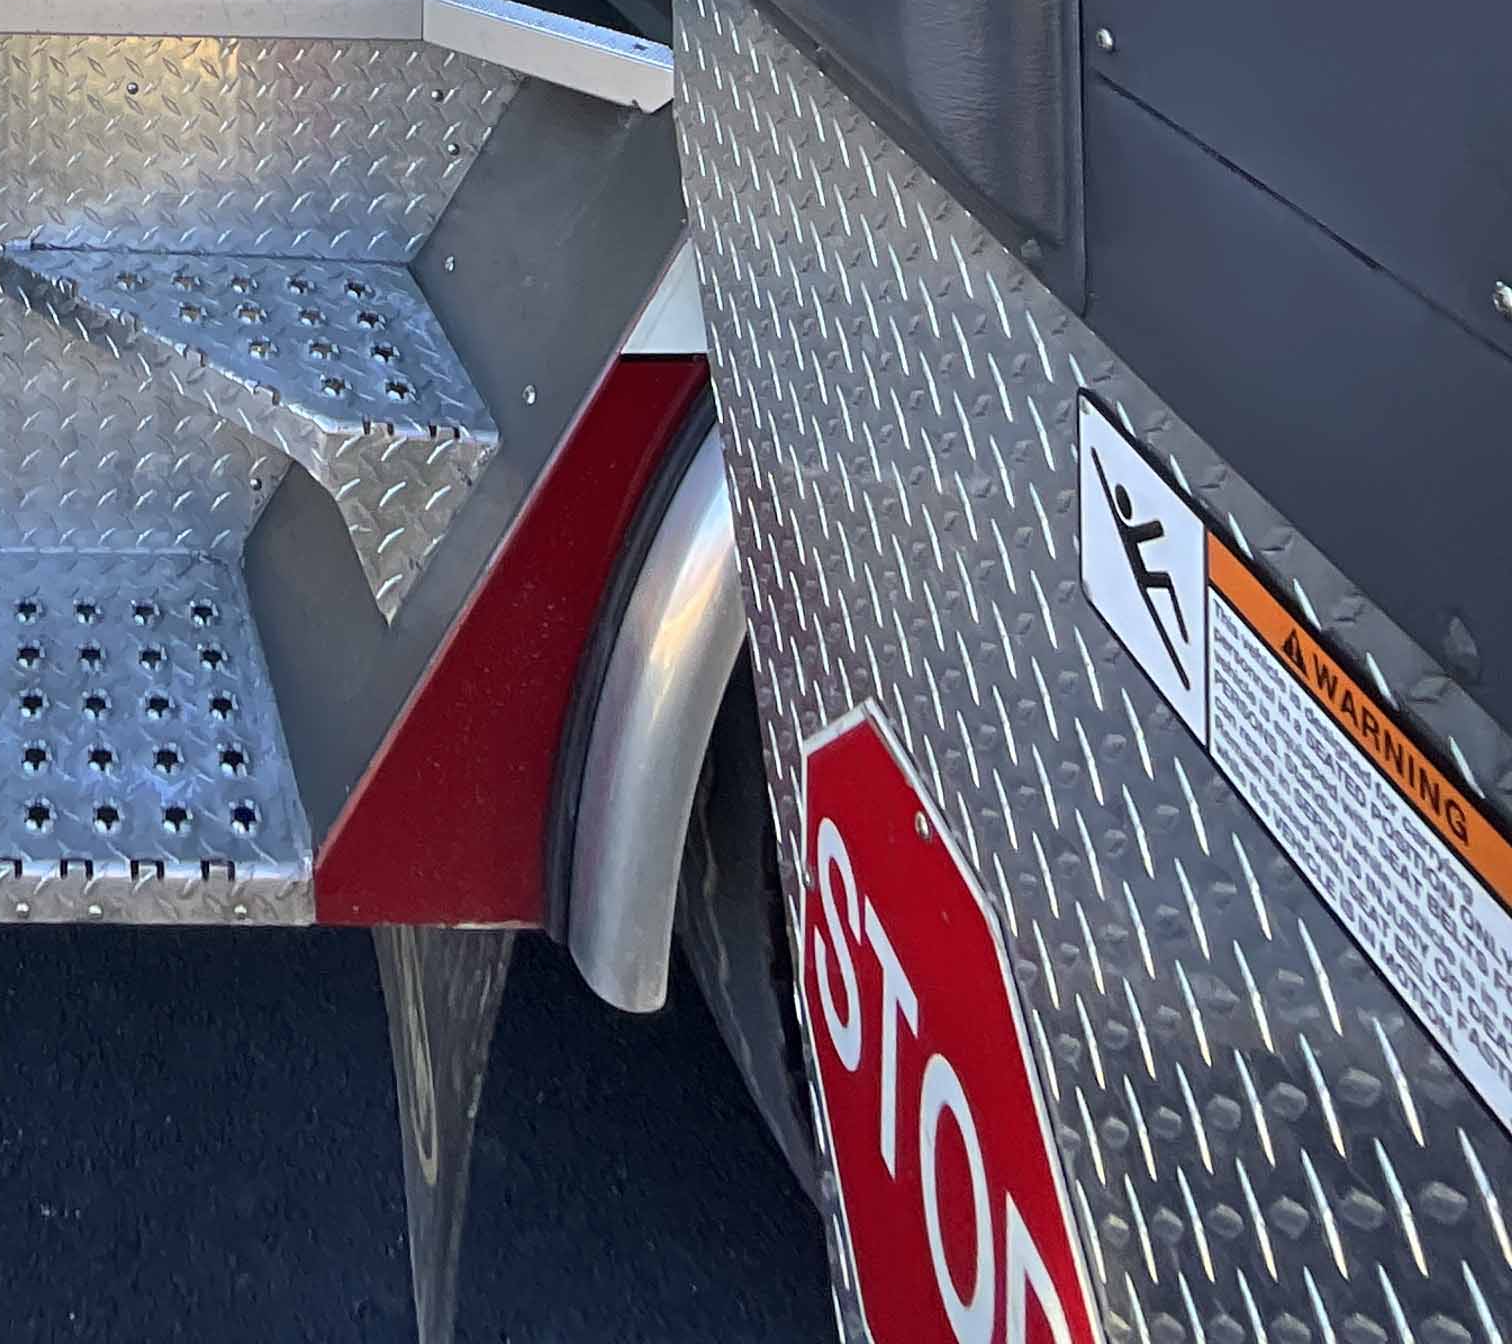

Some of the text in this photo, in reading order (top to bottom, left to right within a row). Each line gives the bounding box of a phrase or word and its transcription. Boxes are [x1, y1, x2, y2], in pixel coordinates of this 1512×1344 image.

[1213, 598, 1473, 910] This vehicle is designed for carrying
[1214, 622, 1274, 707] personnel
[1278, 694, 1289, 723] in
[1293, 715, 1301, 737] a
[1305, 725, 1365, 811] SEATED
[1371, 799, 1454, 912] POSITION
[1214, 693, 1235, 730] can
[1279, 768, 1289, 795] in
[1294, 784, 1361, 882] SERIOUS
[1365, 871, 1429, 964] INJURY
[1434, 952, 1461, 1004] OR
[1467, 991, 1512, 1065] DEA
[1259, 696, 1269, 723] is
[1273, 713, 1337, 805] equipped
[1340, 791, 1373, 845] with
[1377, 832, 1422, 902] SEAT
[1427, 890, 1488, 979] BELTS
[1273, 807, 1336, 902] VEHICLE
[1340, 889, 1353, 923] IS
[1358, 912, 1374, 949] IN
[1285, 748, 1346, 843] Standing
[1351, 828, 1390, 892] while
[1396, 881, 1456, 970] vehicle
[1461, 956, 1475, 992] is
[1480, 980, 1497, 1019] in
[1313, 652, 1469, 849] WARNING
[1348, 875, 1389, 942] SEAT
[1394, 931, 1452, 1020] BELTS
[1456, 1006, 1512, 1094] FAST
